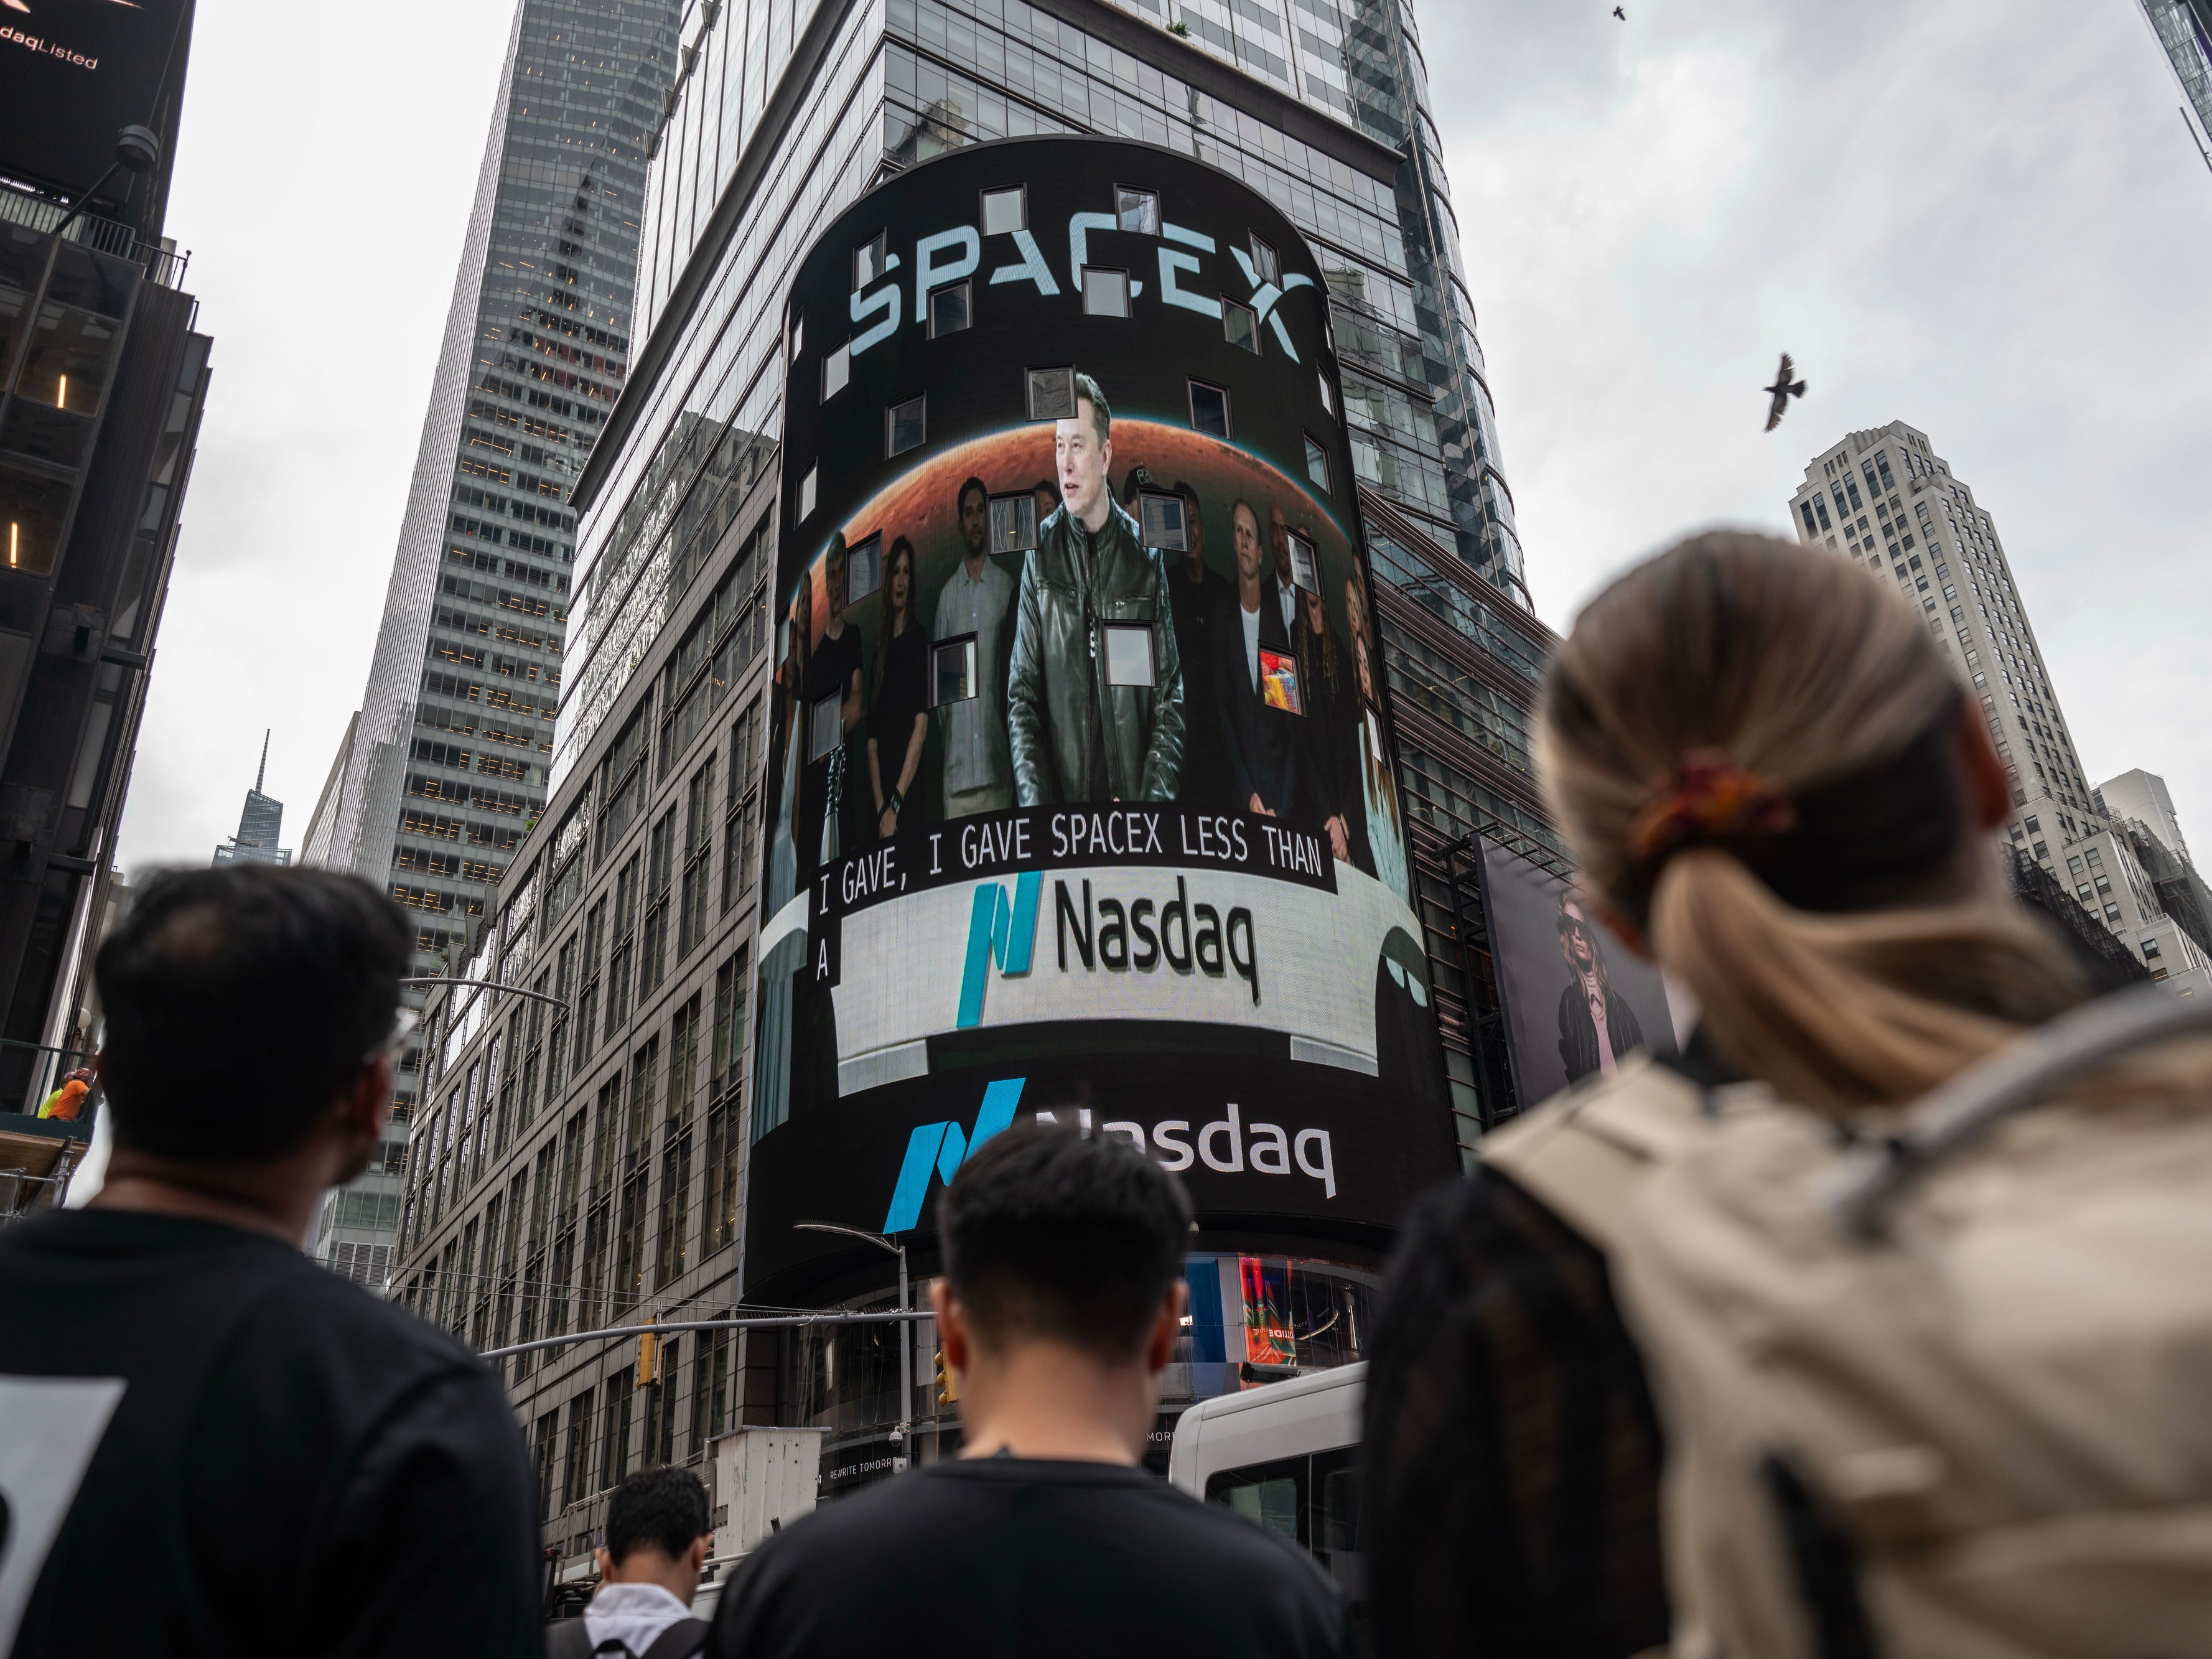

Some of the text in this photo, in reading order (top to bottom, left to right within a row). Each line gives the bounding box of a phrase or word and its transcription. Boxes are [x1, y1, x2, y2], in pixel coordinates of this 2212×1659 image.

[850, 212, 1314, 365] SPACEX
[819, 811, 1322, 915] I GAVE, I GAVE SPACEX LESS THAN
[816, 938, 829, 981] A
[1054, 875, 1262, 1007] Nasdaq
[830, 1456, 903, 1480] REWRITE TOMORR
